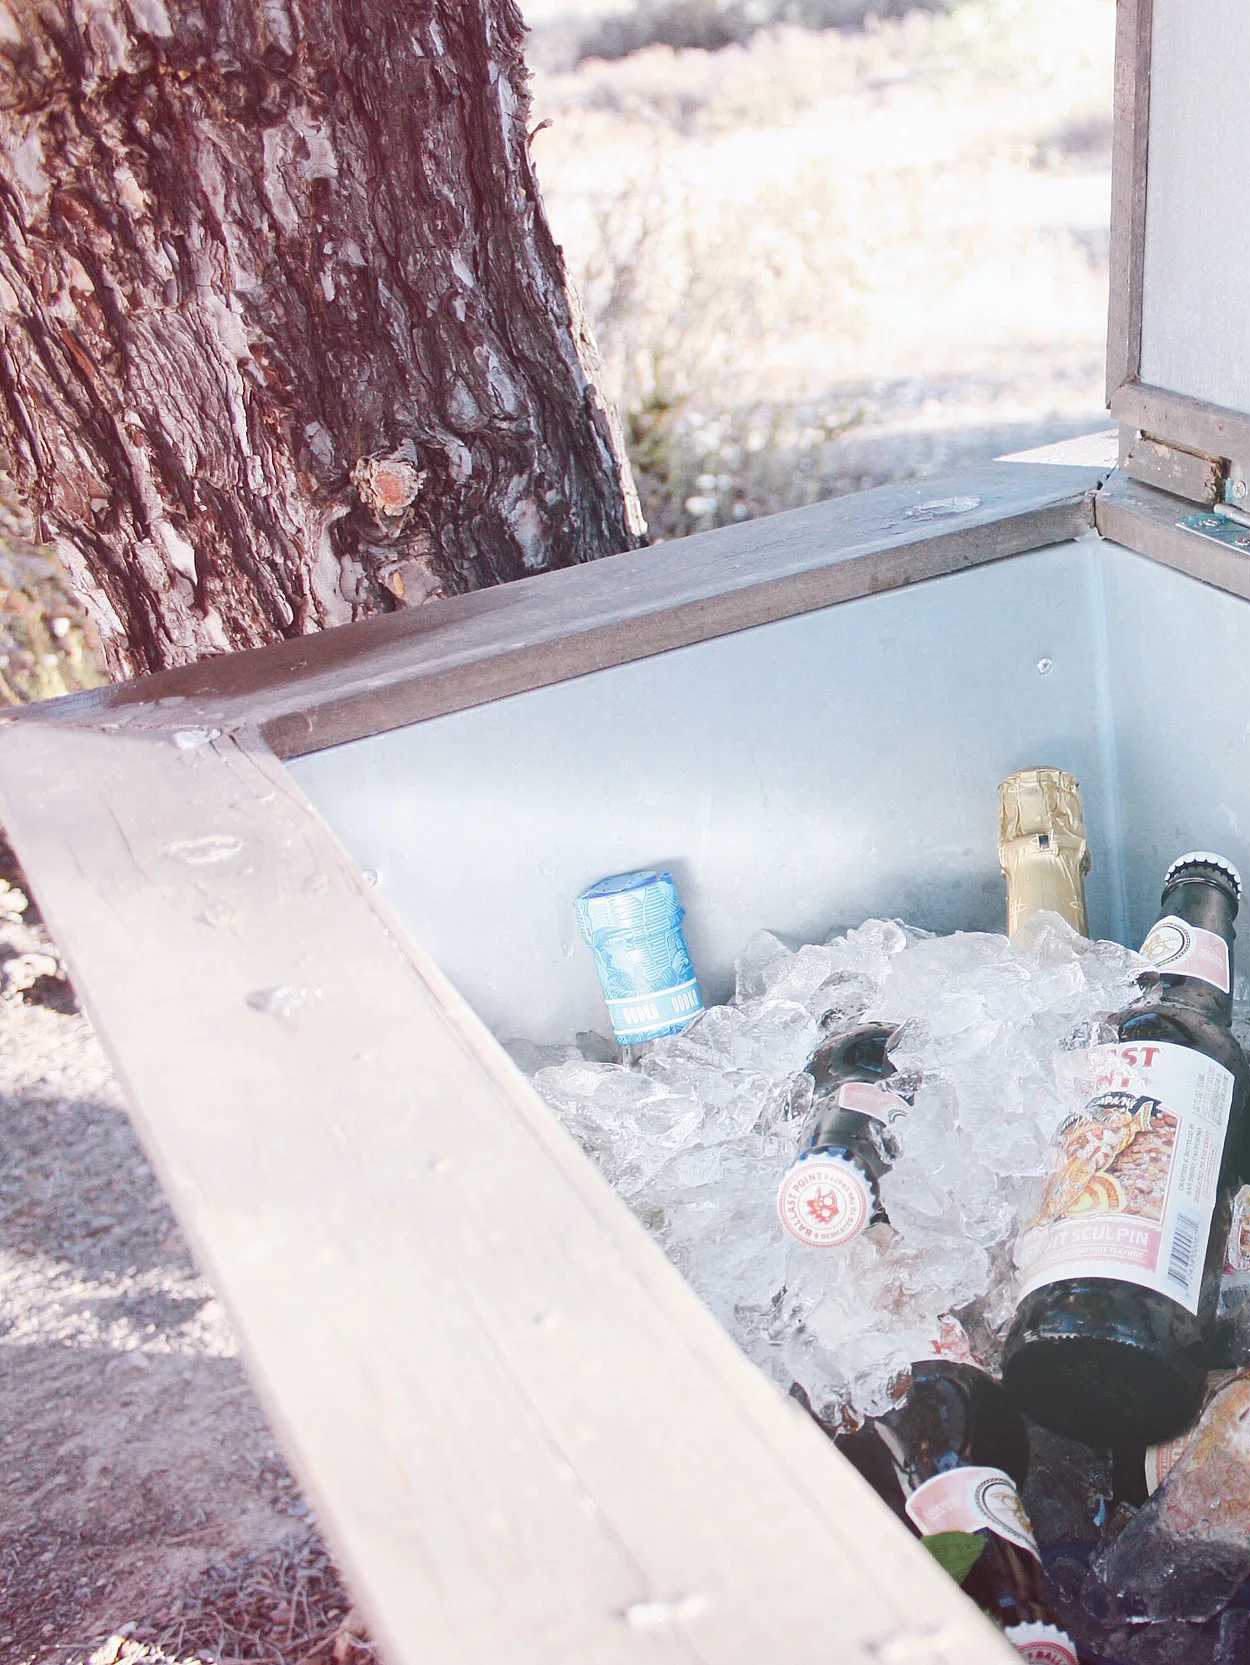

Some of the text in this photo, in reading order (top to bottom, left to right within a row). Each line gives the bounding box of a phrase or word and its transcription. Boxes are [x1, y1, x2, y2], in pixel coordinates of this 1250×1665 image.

[671, 989, 699, 1012] VODKA
[786, 1172, 822, 1236] BALLAST POINT
[1072, 1226, 1149, 1246] SCULPIN
